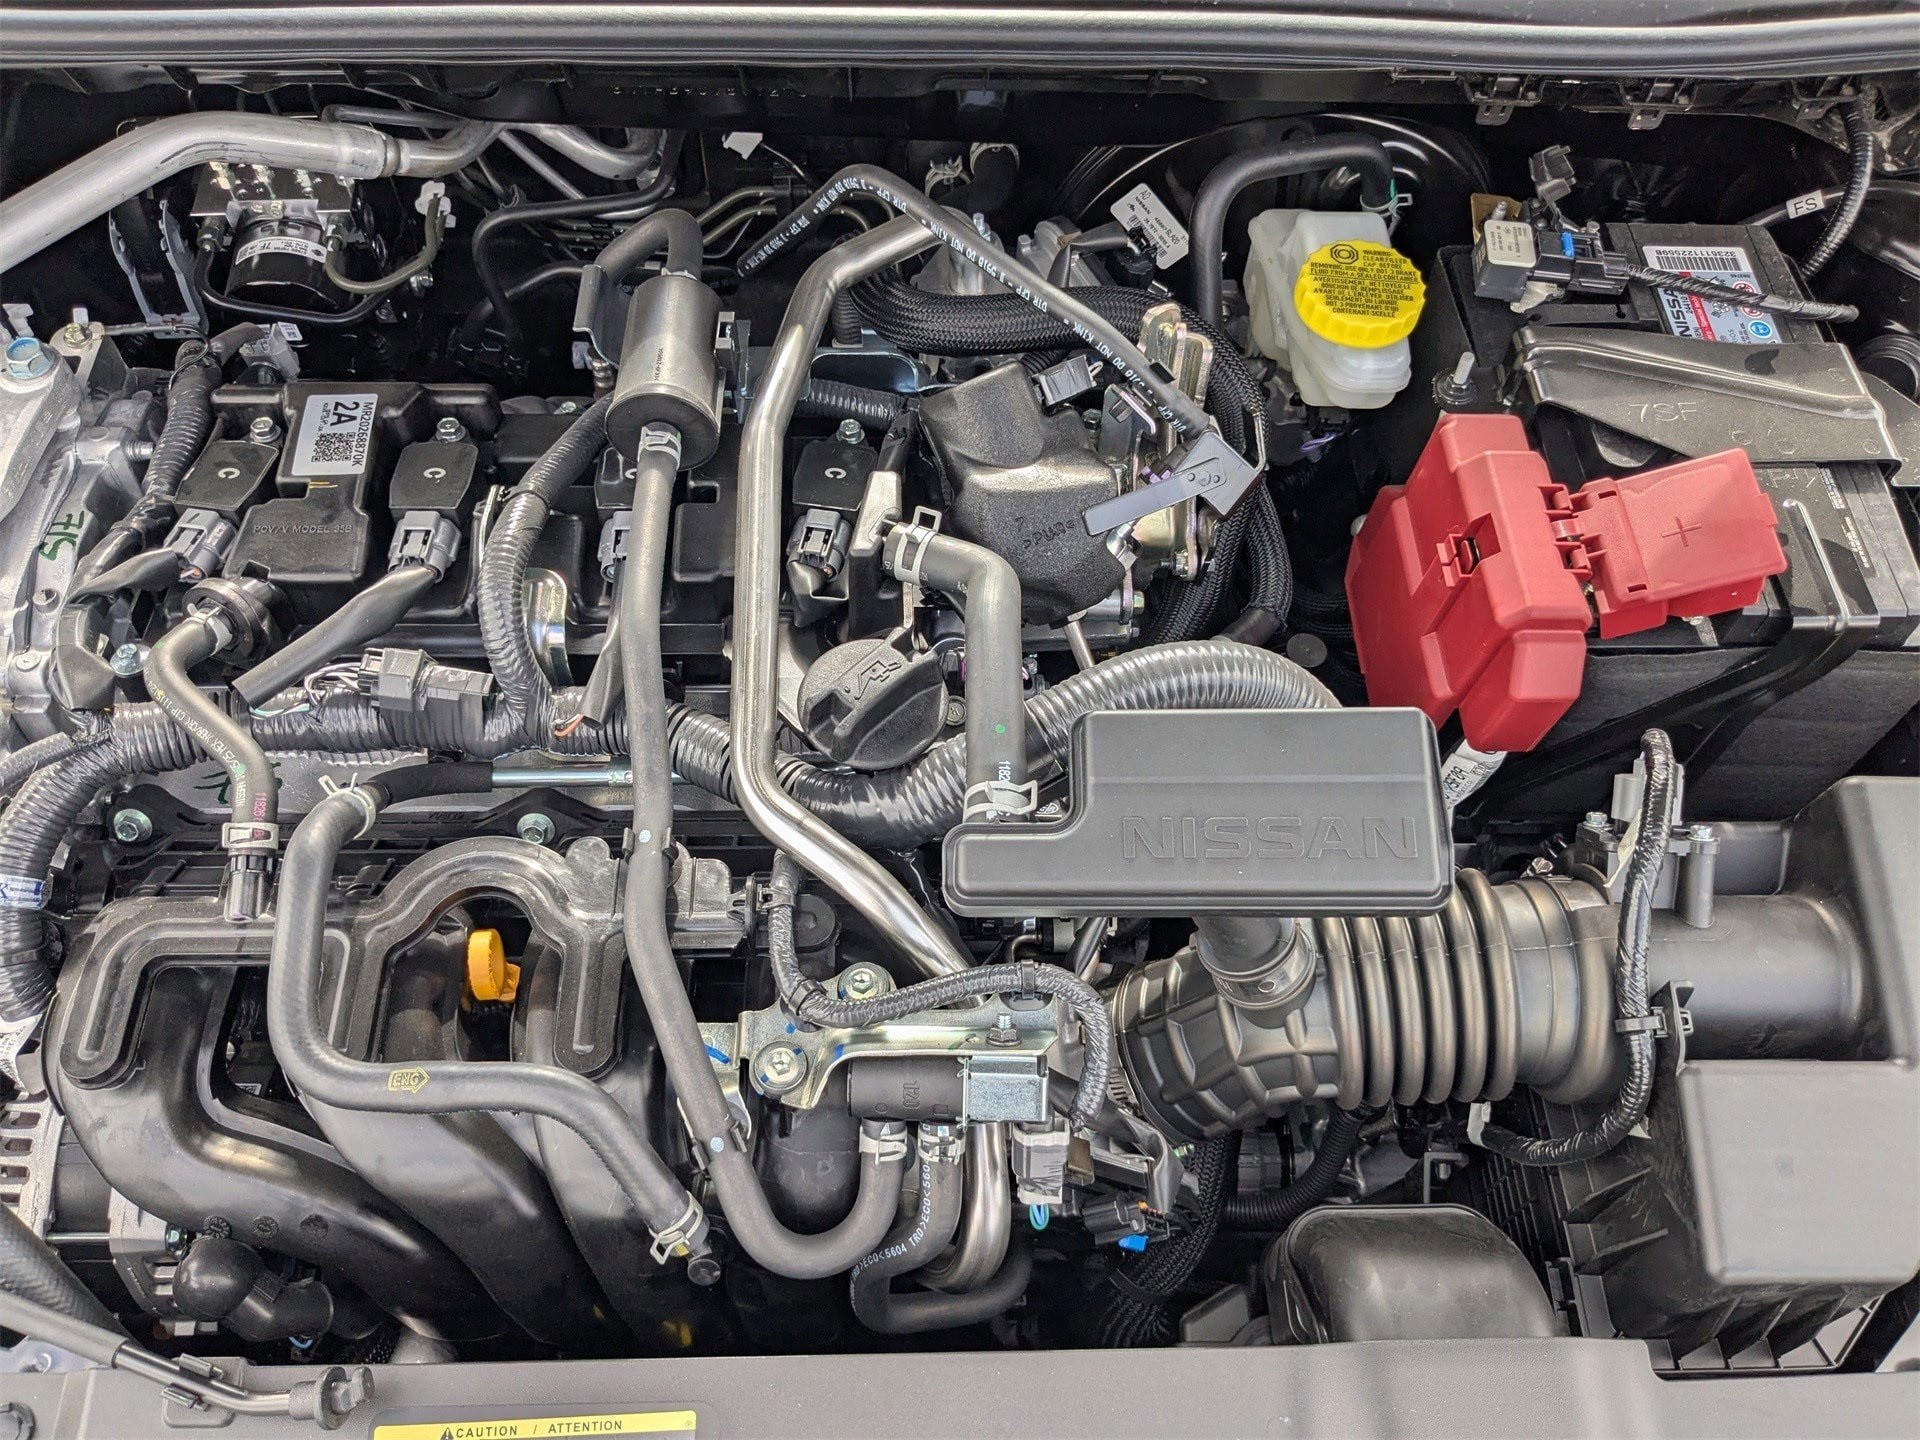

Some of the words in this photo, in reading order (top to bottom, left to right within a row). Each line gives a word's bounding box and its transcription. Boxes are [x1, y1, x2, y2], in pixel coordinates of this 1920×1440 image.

[877, 188, 891, 202] CFP
[893, 196, 907, 212] DTR
[1794, 197, 1818, 216] FS
[930, 222, 948, 242] KINK
[950, 237, 964, 252] NOT
[966, 248, 977, 262] DO
[1016, 285, 1030, 300] CFP
[1033, 295, 1048, 312] DTR
[1664, 288, 1692, 338] NISSA
[1073, 322, 1094, 342] KINK
[1096, 342, 1114, 358] NOT
[330, 401, 360, 427] 2A
[352, 402, 374, 466] MR20268870K
[292, 525, 330, 534] MODEL
[334, 524, 352, 533] 35B
[999, 760, 1011, 780] 1182
[1122, 816, 1418, 860] NISSAN
[393, 1072, 419, 1086] ENG
[456, 1426, 518, 1438] CAUTION
[548, 1420, 623, 1434] ATTENTION
